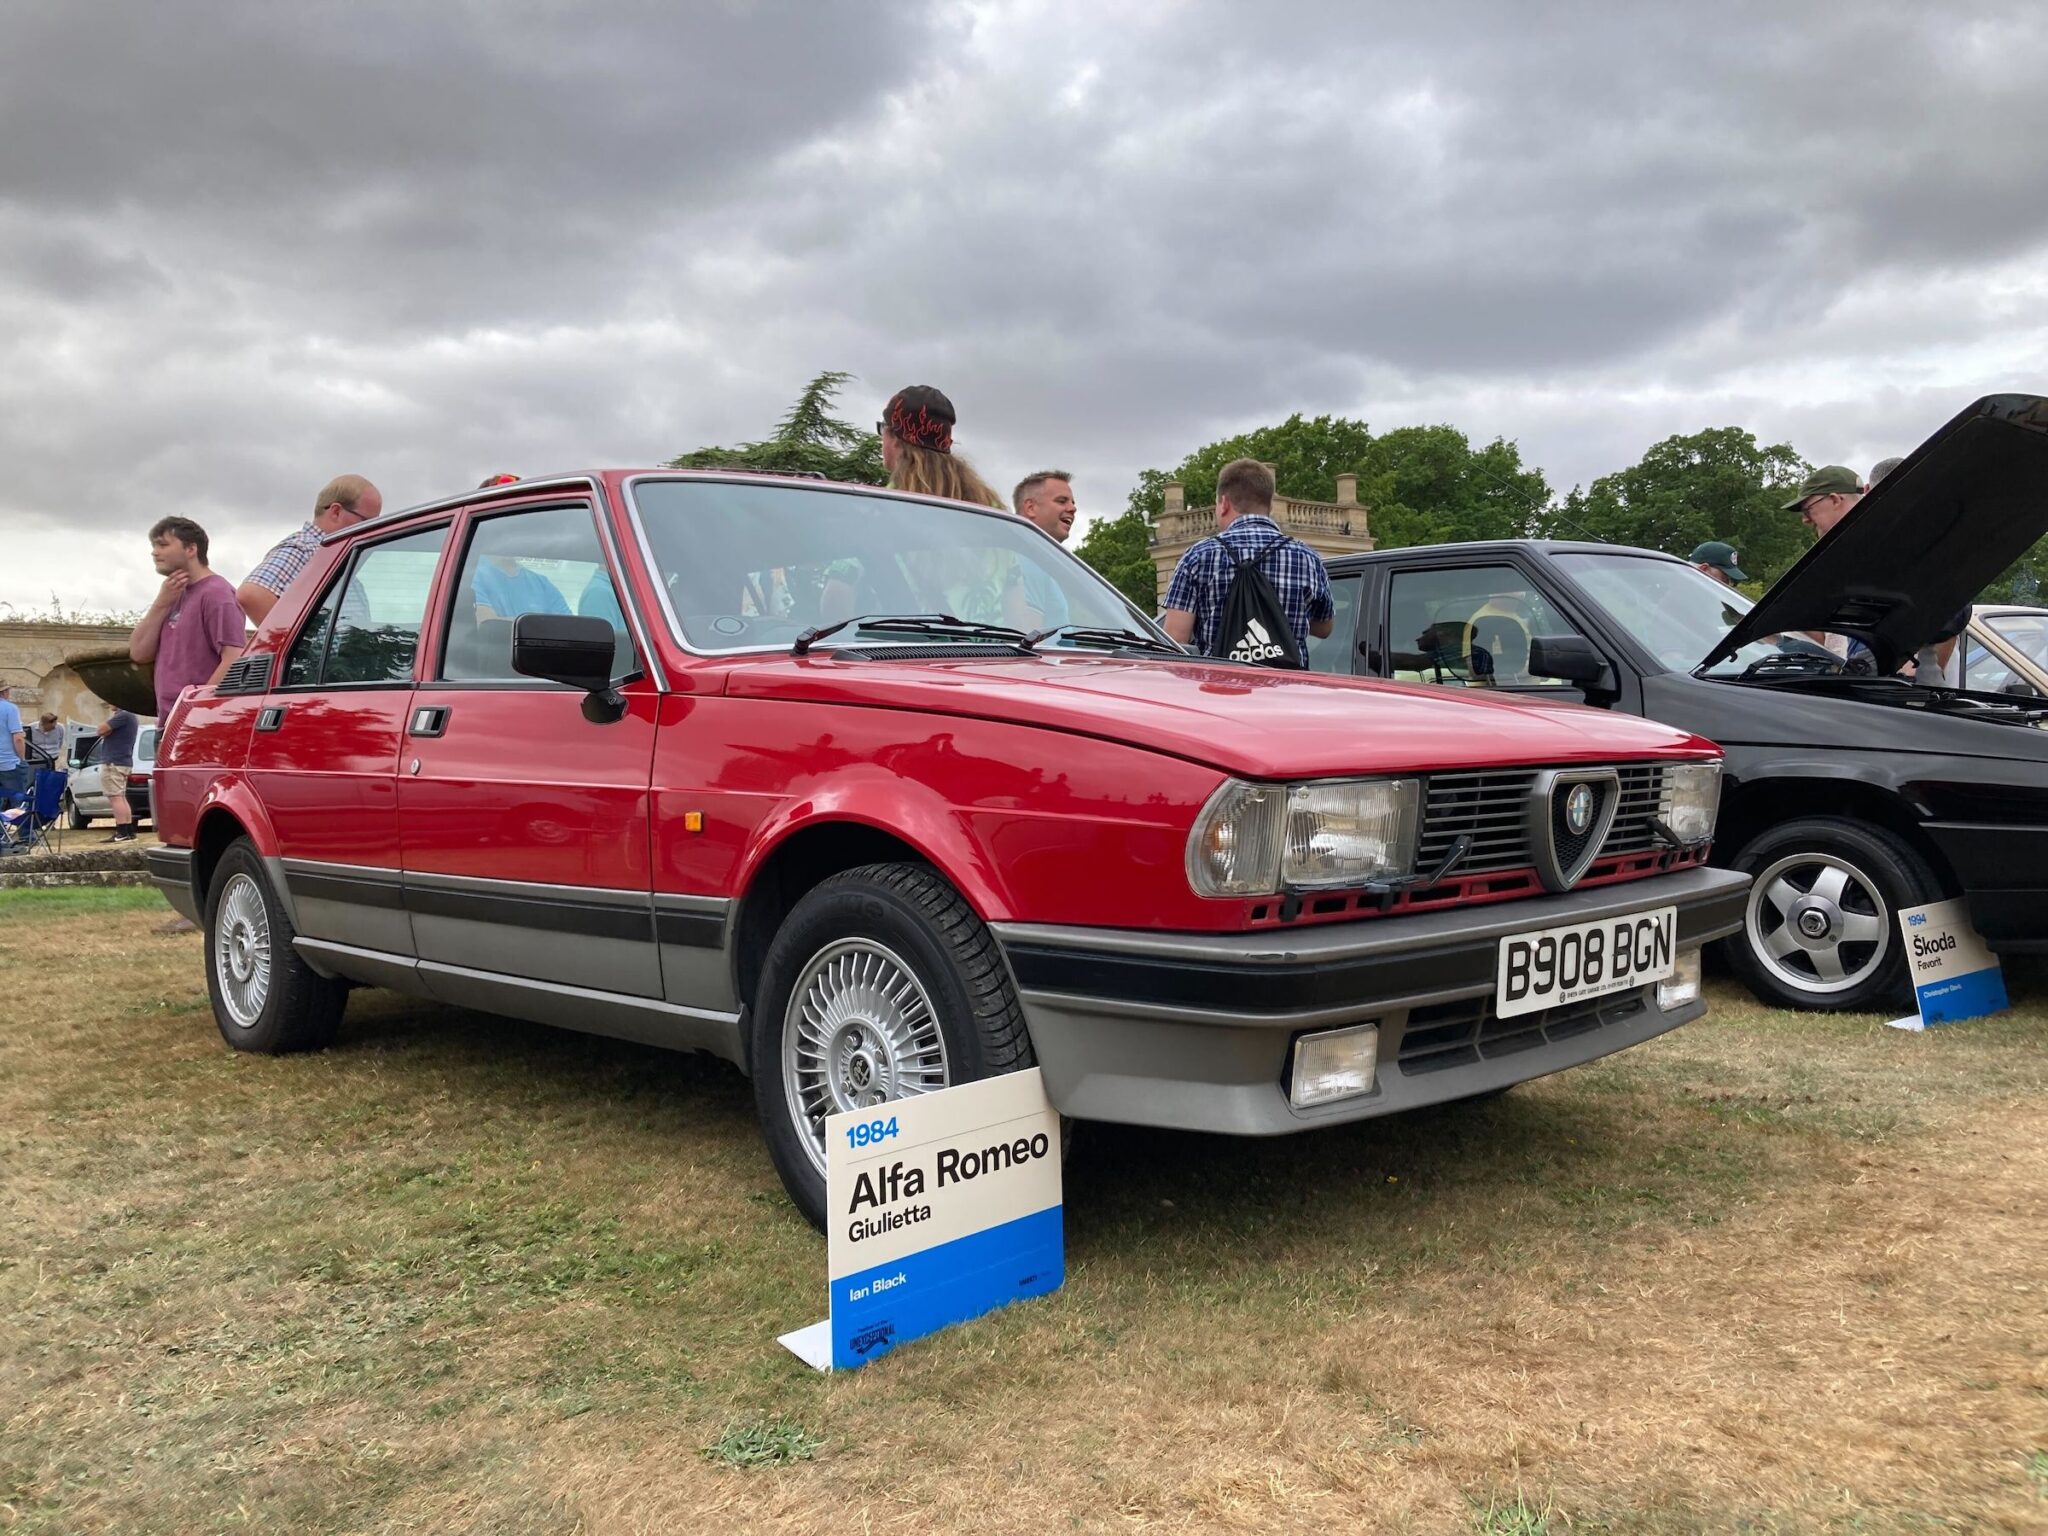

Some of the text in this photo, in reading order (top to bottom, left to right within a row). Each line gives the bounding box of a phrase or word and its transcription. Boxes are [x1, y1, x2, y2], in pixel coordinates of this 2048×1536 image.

[1229, 644, 1284, 662] addas
[1907, 914, 1927, 926] 1994
[1505, 913, 1672, 1002] B908 BGN
[1913, 931, 1957, 957] Škoda
[1917, 957, 1943, 971] Favorit
[846, 1116, 899, 1149] 1984
[848, 1132, 1049, 1215] Alfa Romeo
[848, 1205, 932, 1242] Giulietta
[849, 1272, 907, 1302] Ian Black
